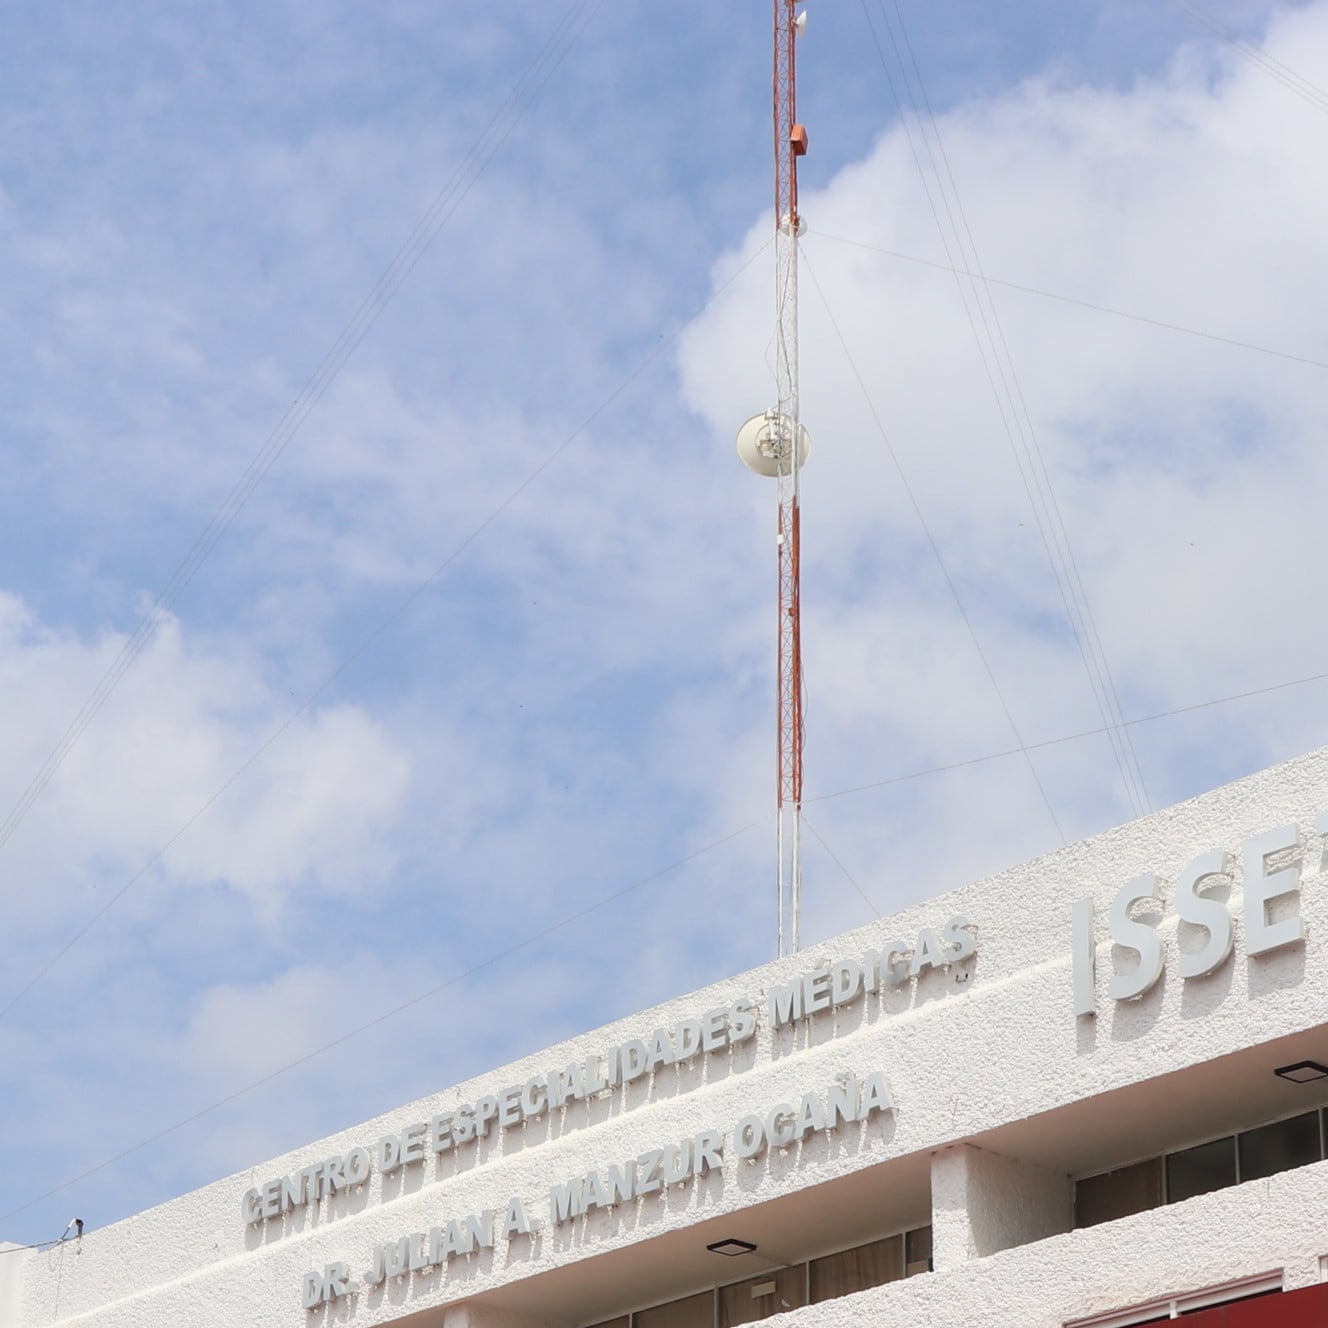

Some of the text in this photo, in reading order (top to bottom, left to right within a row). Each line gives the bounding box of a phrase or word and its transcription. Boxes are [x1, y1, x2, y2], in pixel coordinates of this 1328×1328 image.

[241, 916, 976, 1223] CENTRO DE ESPECIALIDADES MÉDICAS
[302, 1071, 892, 1309] DR. JULIAN A. MANZUR OCAÑA
